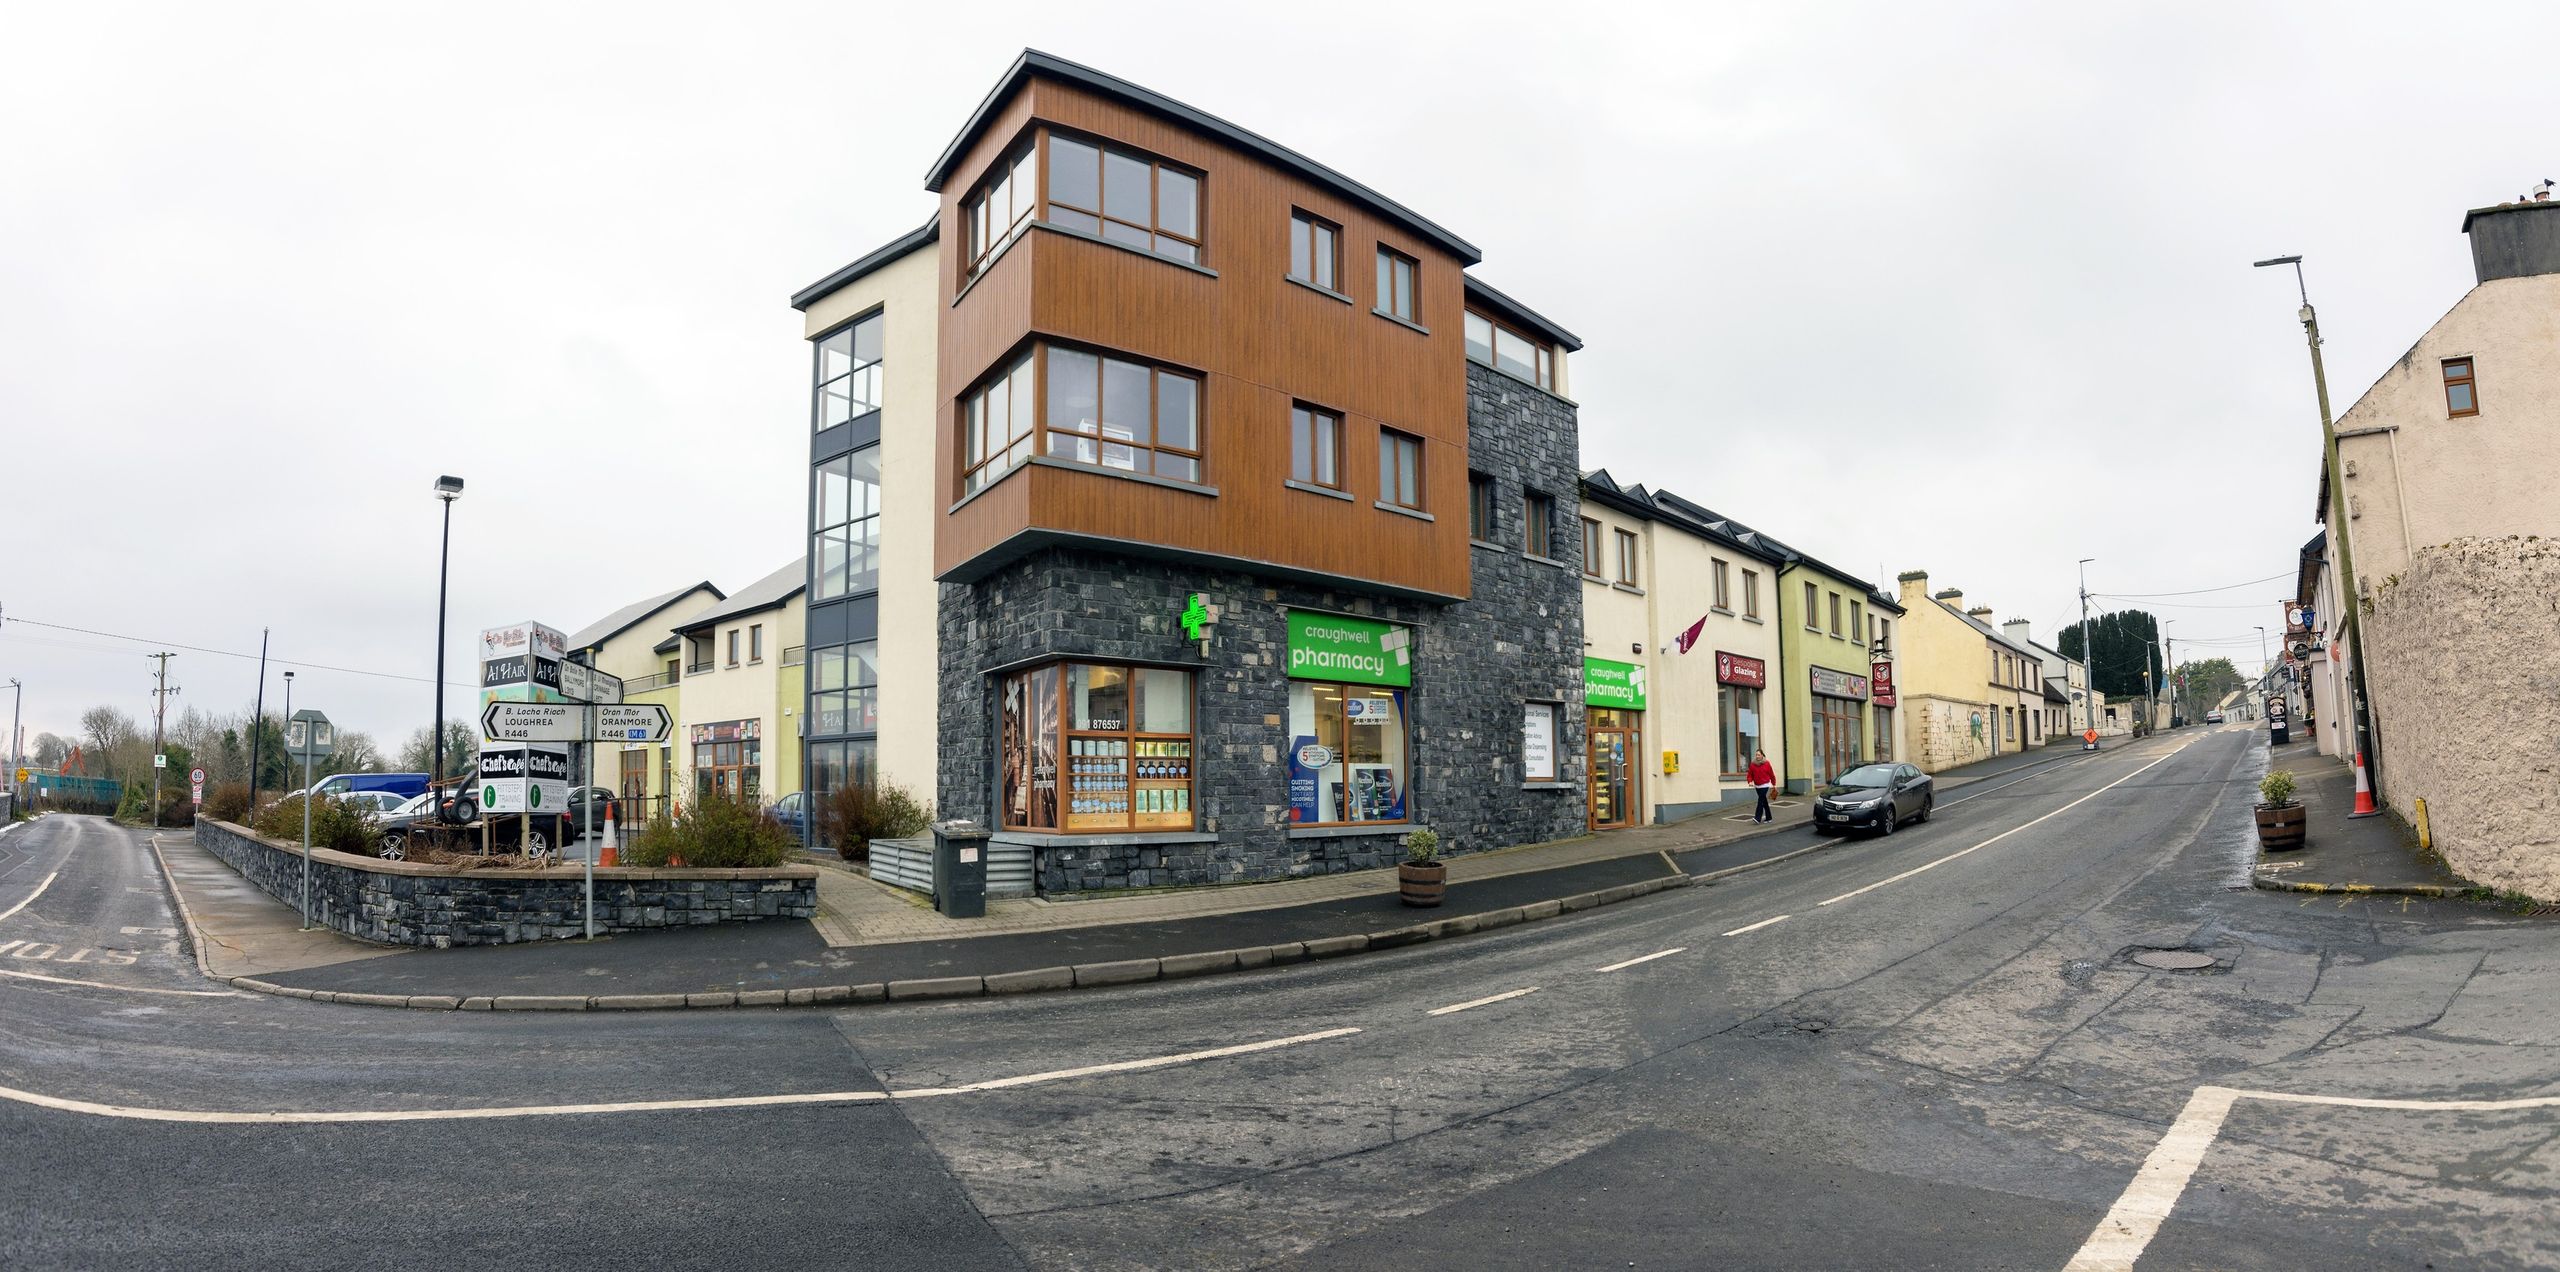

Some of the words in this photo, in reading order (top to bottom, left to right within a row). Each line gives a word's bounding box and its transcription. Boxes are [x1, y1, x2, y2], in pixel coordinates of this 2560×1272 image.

[1305, 626, 1370, 643] craughwell
[1293, 646, 1384, 676] pharmacy
[500, 662, 526, 679] HAIR
[1590, 668, 1626, 680] craughwell
[1734, 666, 1757, 678] Glazing
[1585, 681, 1634, 702] pharmacy
[1369, 704, 1375, 714] 5
[505, 718, 553, 726] LOUGHREA
[601, 718, 652, 726] ORANMORE
[1092, 719, 1121, 730] 876537
[1302, 751, 1309, 761] 5
[481, 754, 507, 772] Chef's
[529, 755, 552, 772] Chef's
